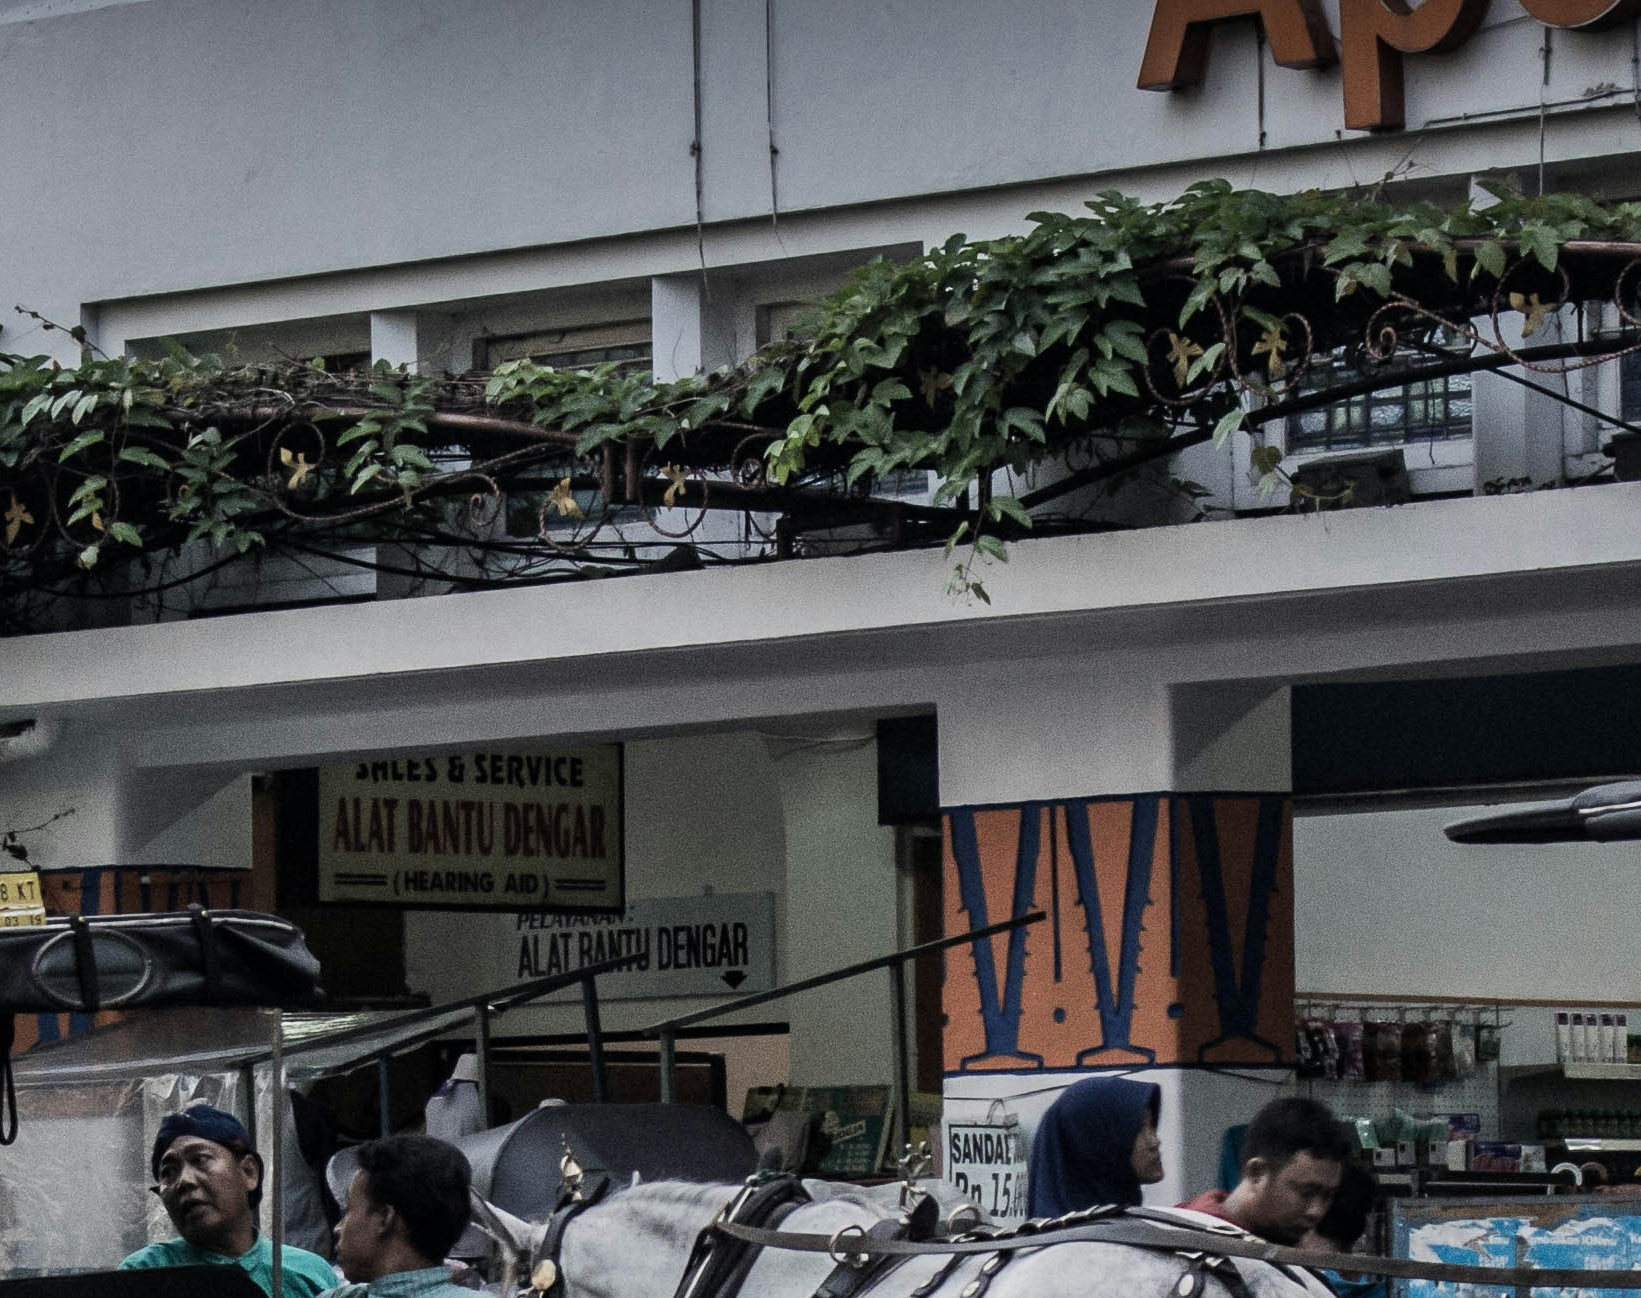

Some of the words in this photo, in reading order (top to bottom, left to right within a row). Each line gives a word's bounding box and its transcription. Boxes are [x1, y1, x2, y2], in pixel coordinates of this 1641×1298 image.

[475, 754, 584, 787] SERVICE
[334, 797, 398, 852] ALAT
[409, 799, 495, 857] BANTU
[503, 802, 607, 858] DENGAR
[16, 880, 35, 900] KT
[519, 932, 573, 978] ALAT
[658, 922, 749, 970] DENGAR
[952, 1133, 1011, 1165] SANDAL
